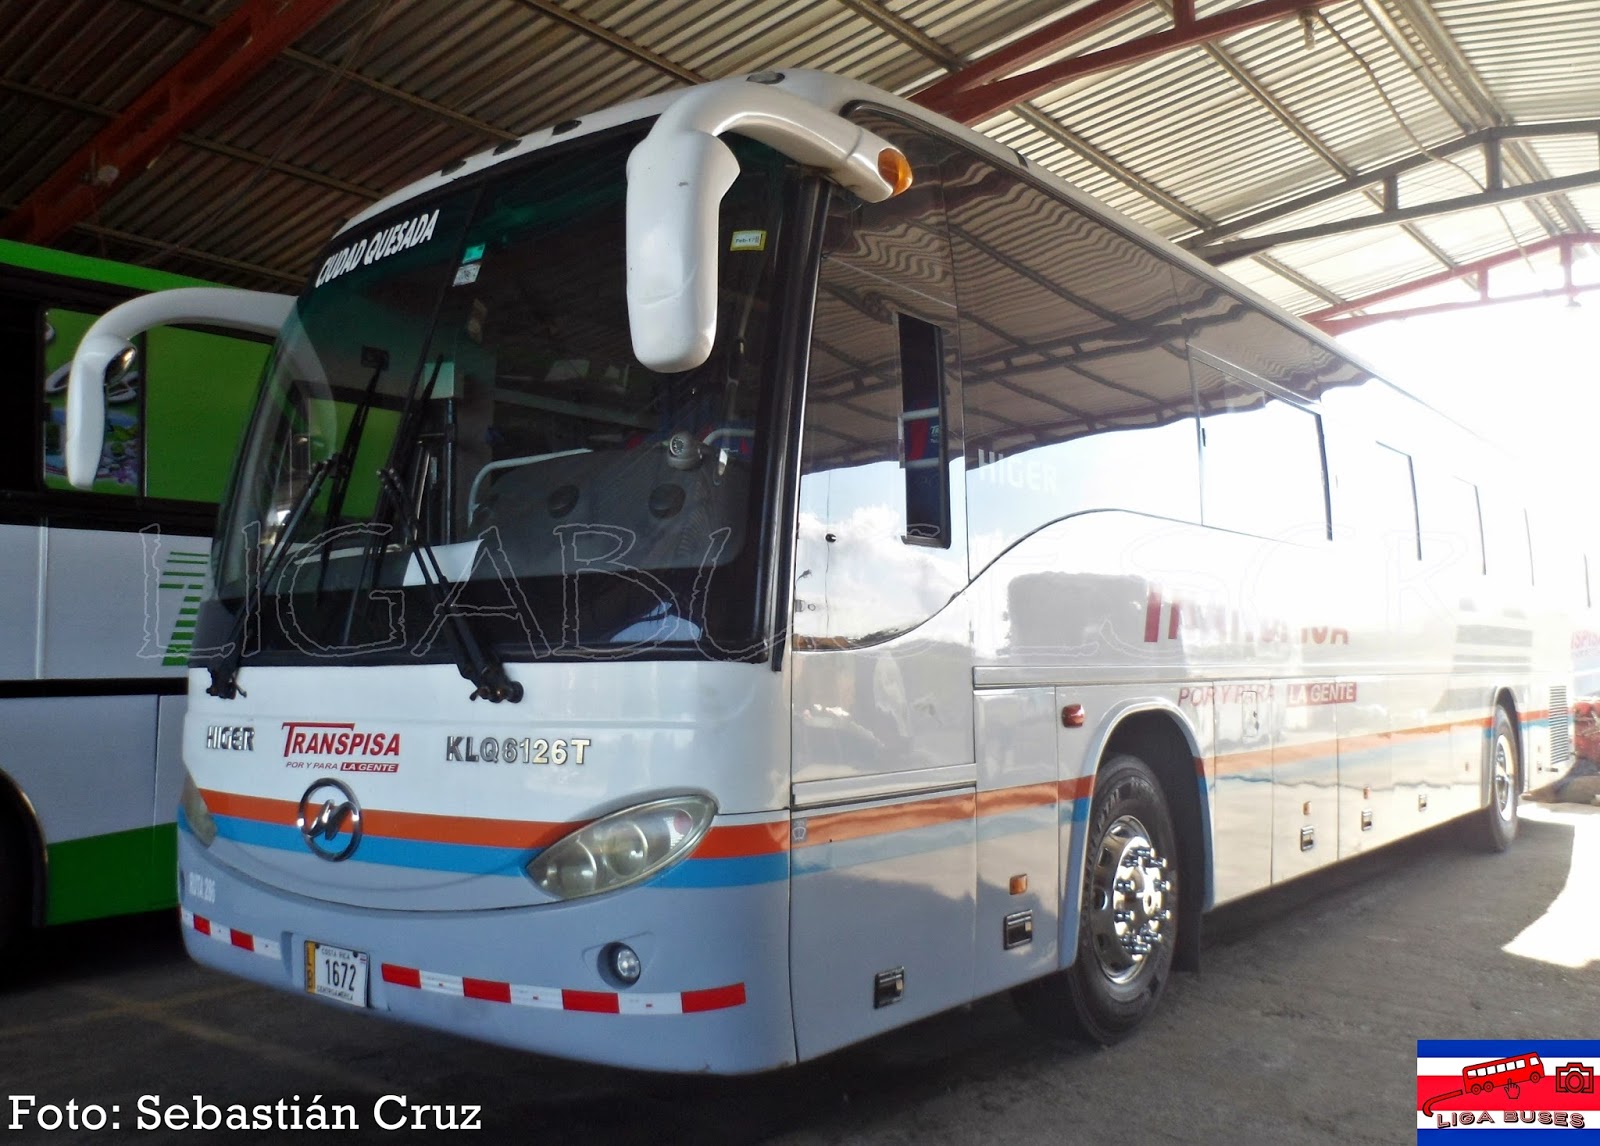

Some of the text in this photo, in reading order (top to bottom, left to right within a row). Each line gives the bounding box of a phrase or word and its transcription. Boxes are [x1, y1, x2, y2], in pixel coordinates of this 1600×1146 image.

[315, 209, 440, 288] CIUDAD QUESADA
[978, 448, 1057, 497] HIGER
[1289, 686, 1306, 704] LA
[1311, 683, 1354, 702] GENTE
[206, 726, 255, 751] HIGER
[281, 722, 400, 757] TRANSPISA
[446, 736, 591, 765] KLQ6126T
[286, 761, 304, 769] POR
[313, 762, 338, 770] PARA
[343, 763, 357, 771] LA
[359, 763, 396, 772] GENTE
[322, 947, 336, 957] COSTA
[326, 959, 356, 991] 1672
